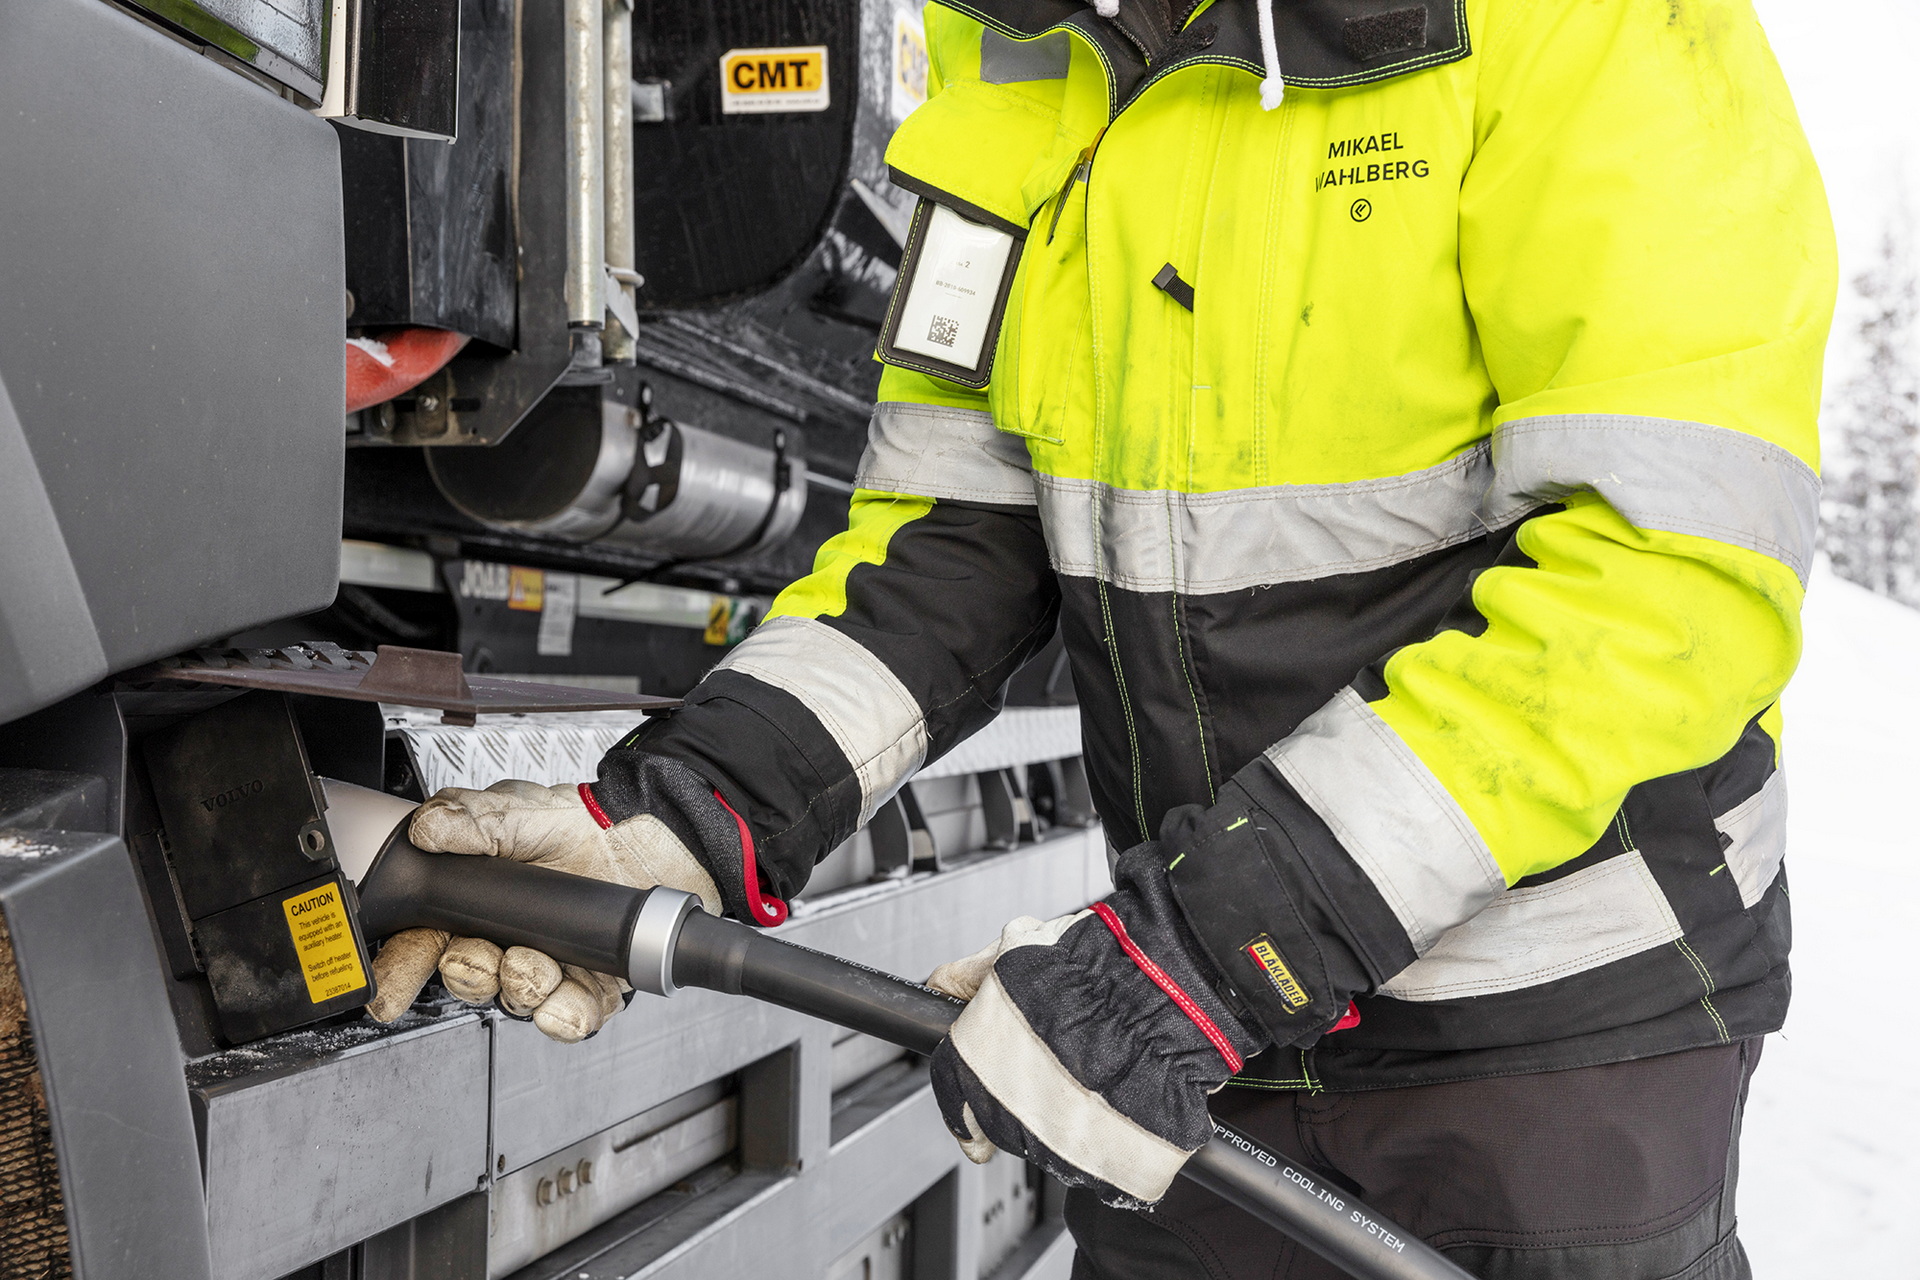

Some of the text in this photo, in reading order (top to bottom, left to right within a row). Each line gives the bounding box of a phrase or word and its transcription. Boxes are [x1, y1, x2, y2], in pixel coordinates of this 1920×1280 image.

[733, 61, 809, 89] CMT
[1328, 132, 1404, 159] MIKAEL
[200, 779, 264, 813] VOLVO
[291, 891, 334, 916] CAUTION
[298, 920, 343, 942] equipped with an
[299, 911, 336, 930] This vehicle is
[303, 938, 325, 952] auxiliary
[307, 951, 352, 972] Switch off heater
[311, 969, 329, 982] before
[1255, 945, 1304, 1004] BLÅKLÄDER
[1282, 1166, 1345, 1212] COOLING
[1350, 1210, 1405, 1253] SYSTEM
